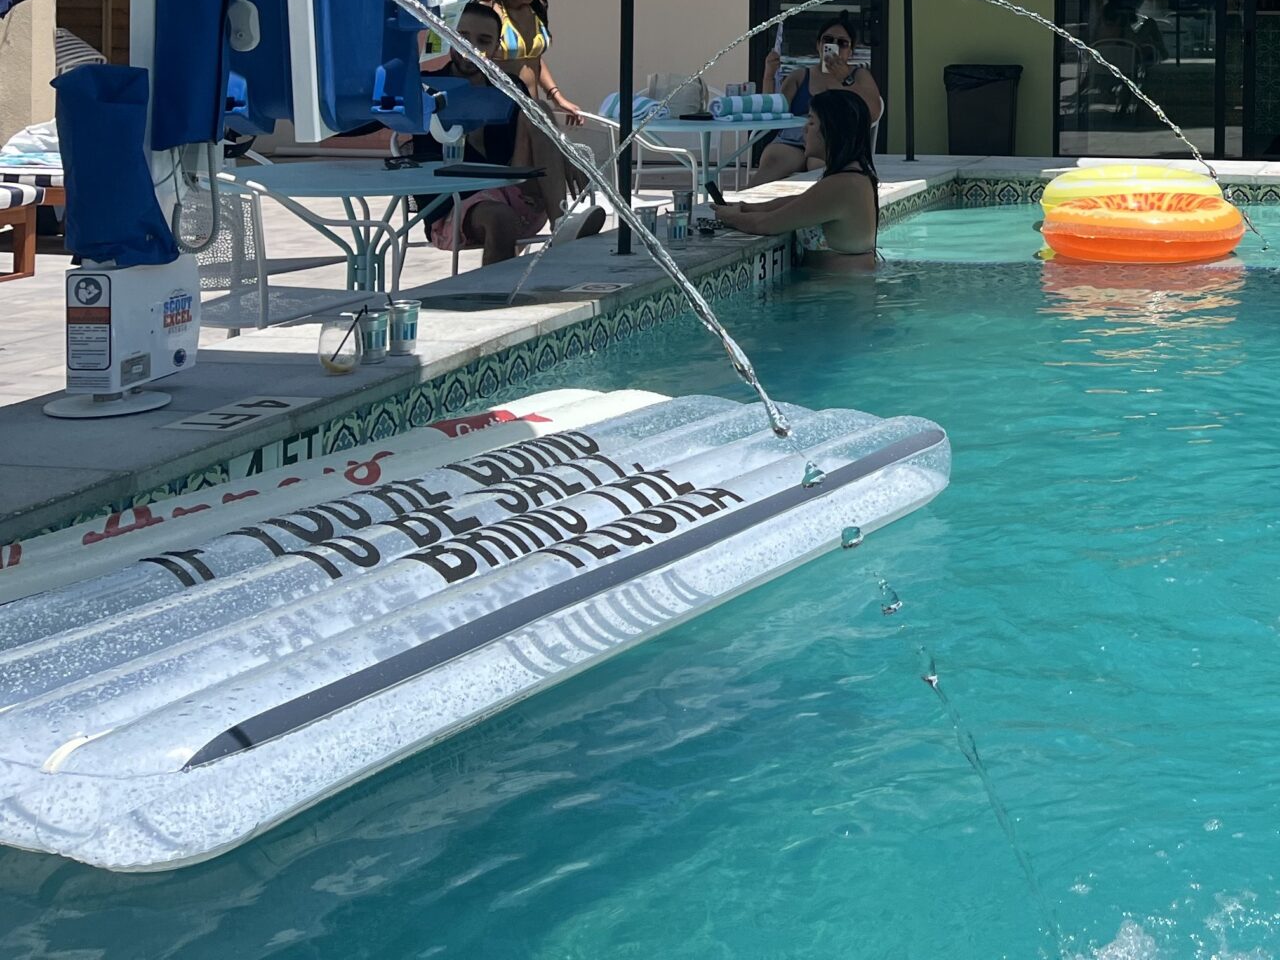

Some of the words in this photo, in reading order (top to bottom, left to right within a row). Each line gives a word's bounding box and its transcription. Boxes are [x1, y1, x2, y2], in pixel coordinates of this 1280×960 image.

[758, 252, 767, 280] 3
[771, 244, 786, 277] FT
[163, 309, 193, 328] EXCEL
[164, 295, 192, 314] SCOUT
[139, 548, 216, 587] IF
[224, 478, 453, 557] YOURE
[284, 535, 381, 580] TO
[376, 505, 483, 548] BE
[397, 505, 588, 584] BRING
[581, 470, 696, 516] THE
[538, 487, 745, 569] TEQUILA
